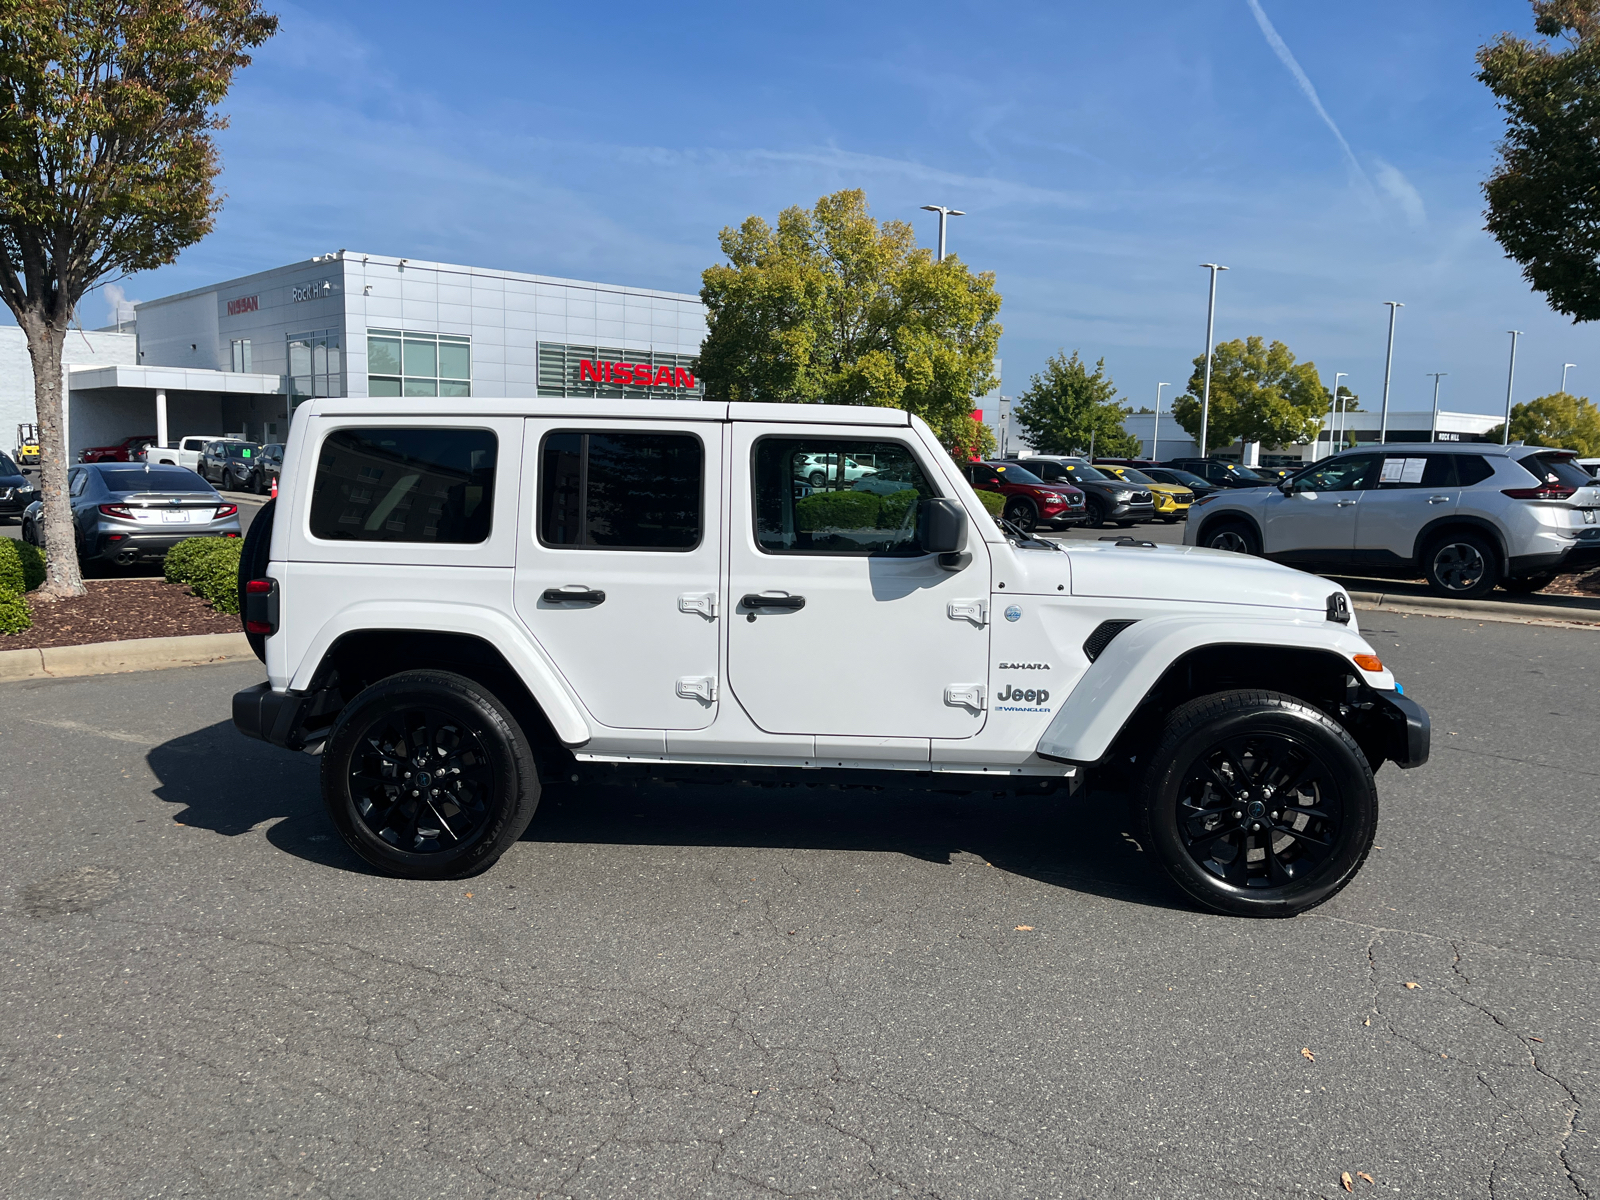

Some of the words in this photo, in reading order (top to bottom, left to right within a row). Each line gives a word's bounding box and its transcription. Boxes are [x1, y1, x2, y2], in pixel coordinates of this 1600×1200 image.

[227, 295, 260, 316] NISSAN
[580, 359, 695, 388] NISSAN
[1438, 432, 1450, 441] ROCK
[1450, 433, 1460, 442] HILL
[998, 662, 1051, 670] SAHARA
[997, 684, 1050, 706] Jeep
